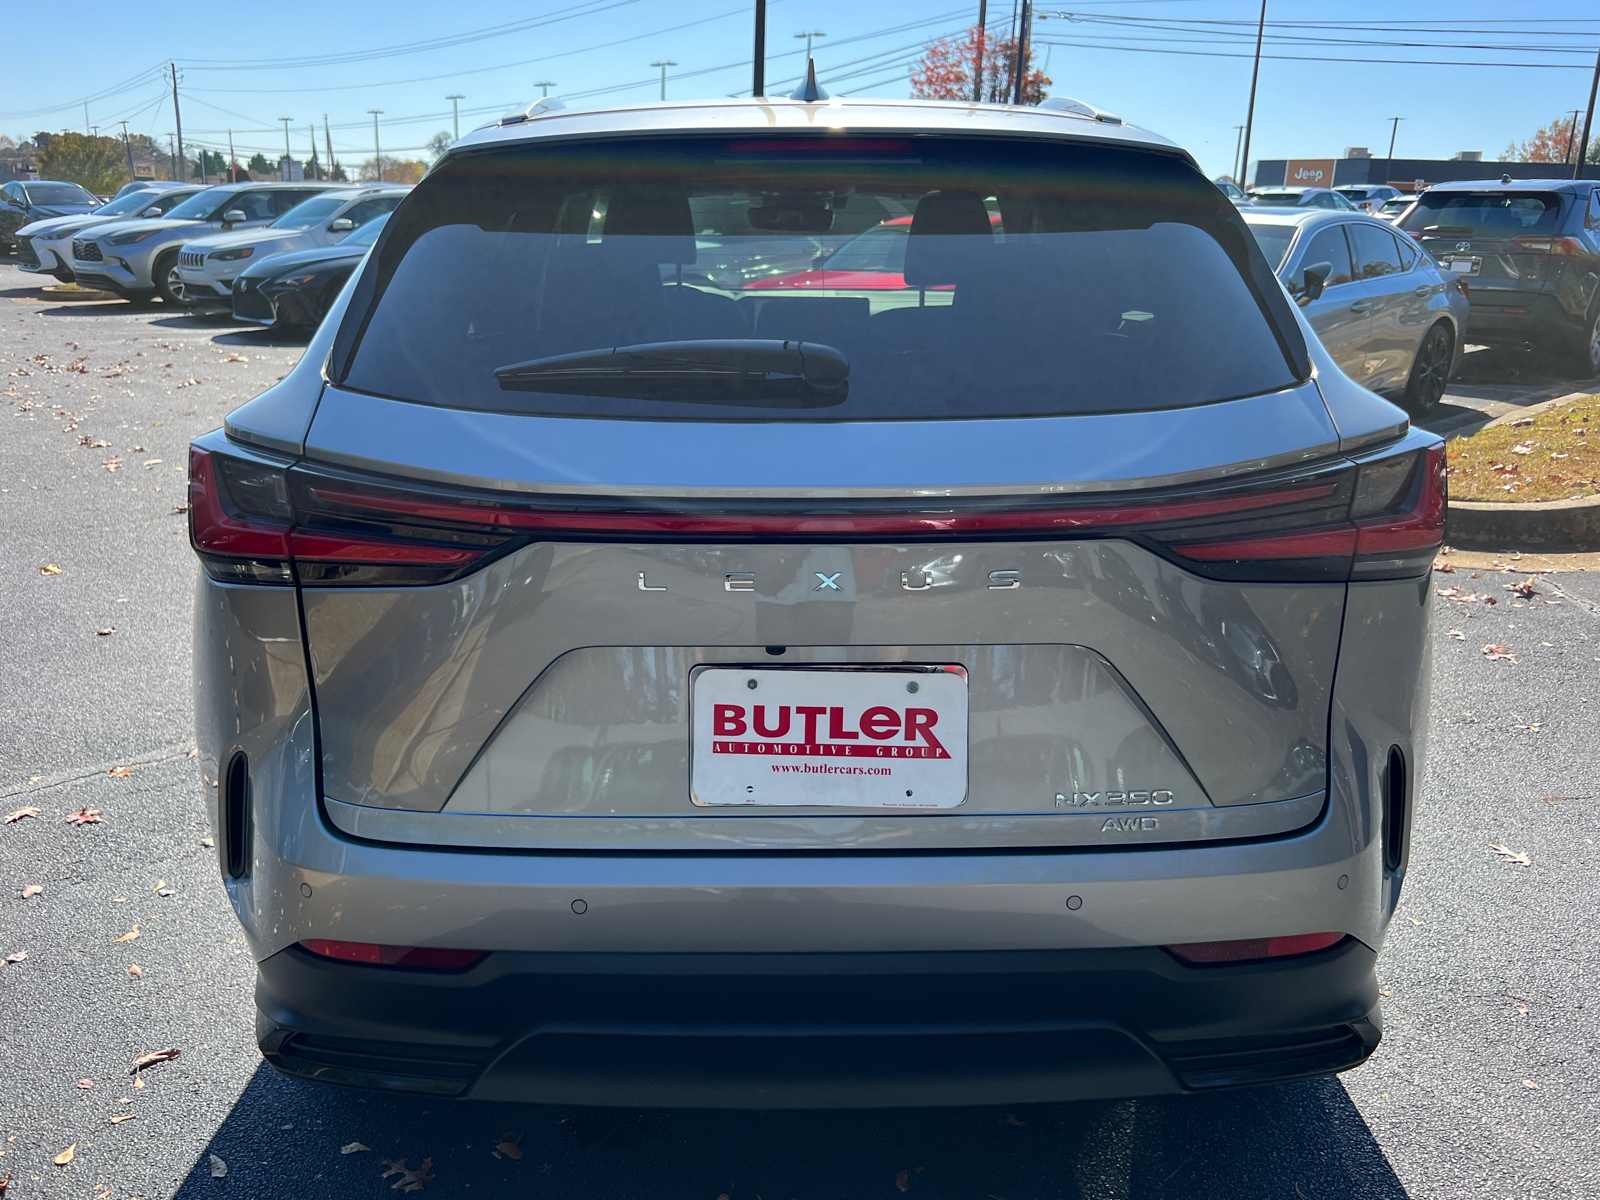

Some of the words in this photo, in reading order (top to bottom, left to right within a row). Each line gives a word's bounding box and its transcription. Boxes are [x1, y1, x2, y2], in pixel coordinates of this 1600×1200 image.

[1295, 167, 1324, 181] Jeep
[638, 570, 1020, 592] LEXUS
[714, 744, 852, 755] AUTOMOTIVE
[876, 746, 943, 758] GROUP
[771, 763, 892, 776] www.butlercars.com
[1100, 817, 1159, 832] AWD
